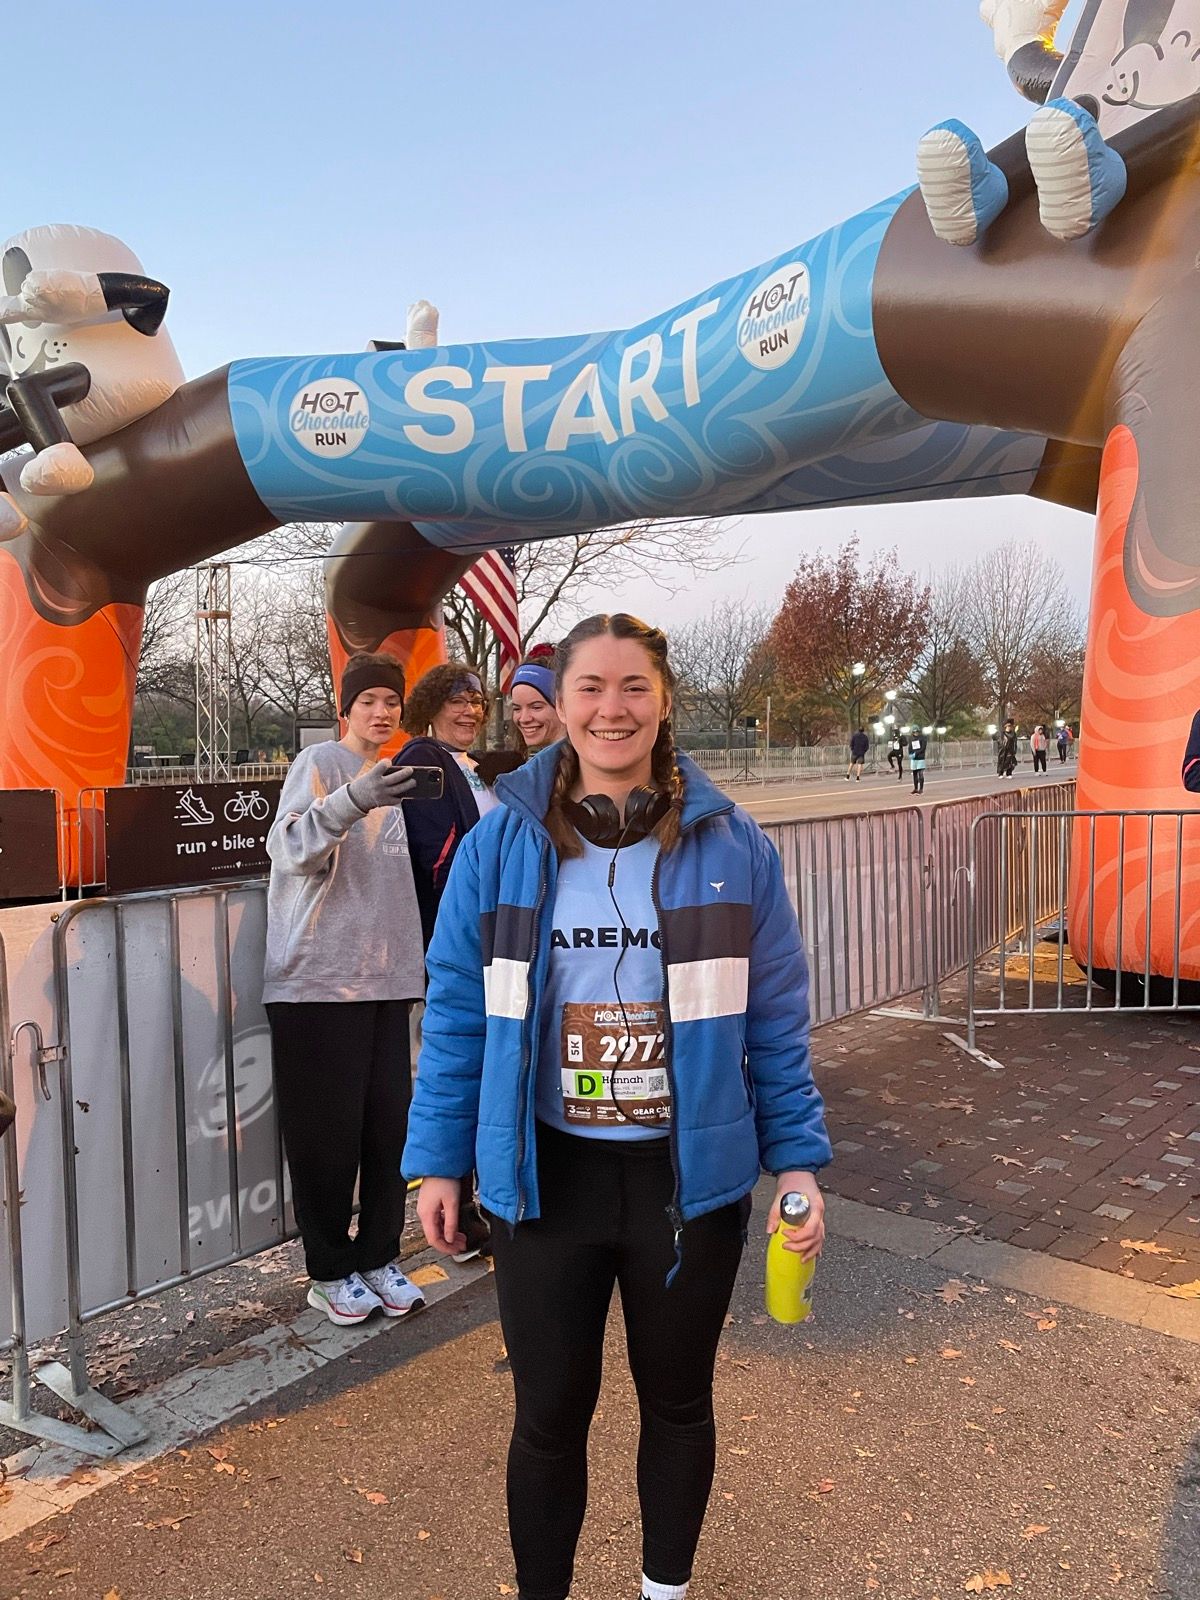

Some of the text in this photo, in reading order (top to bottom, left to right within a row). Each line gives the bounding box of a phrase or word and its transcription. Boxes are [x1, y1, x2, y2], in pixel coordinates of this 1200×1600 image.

[747, 271, 805, 318] HOT
[739, 294, 809, 347] Chocolate
[759, 328, 789, 357] RUN
[402, 297, 721, 454] START
[300, 391, 360, 414] HOT
[290, 409, 370, 433] Chocolate
[314, 432, 347, 447] RUN
[176, 833, 255, 855] run bike
[594, 1010, 620, 1022] HOT
[571, 1040, 580, 1056] 5K
[577, 1075, 596, 1095] D
[633, 1108, 655, 1116] GEAR
